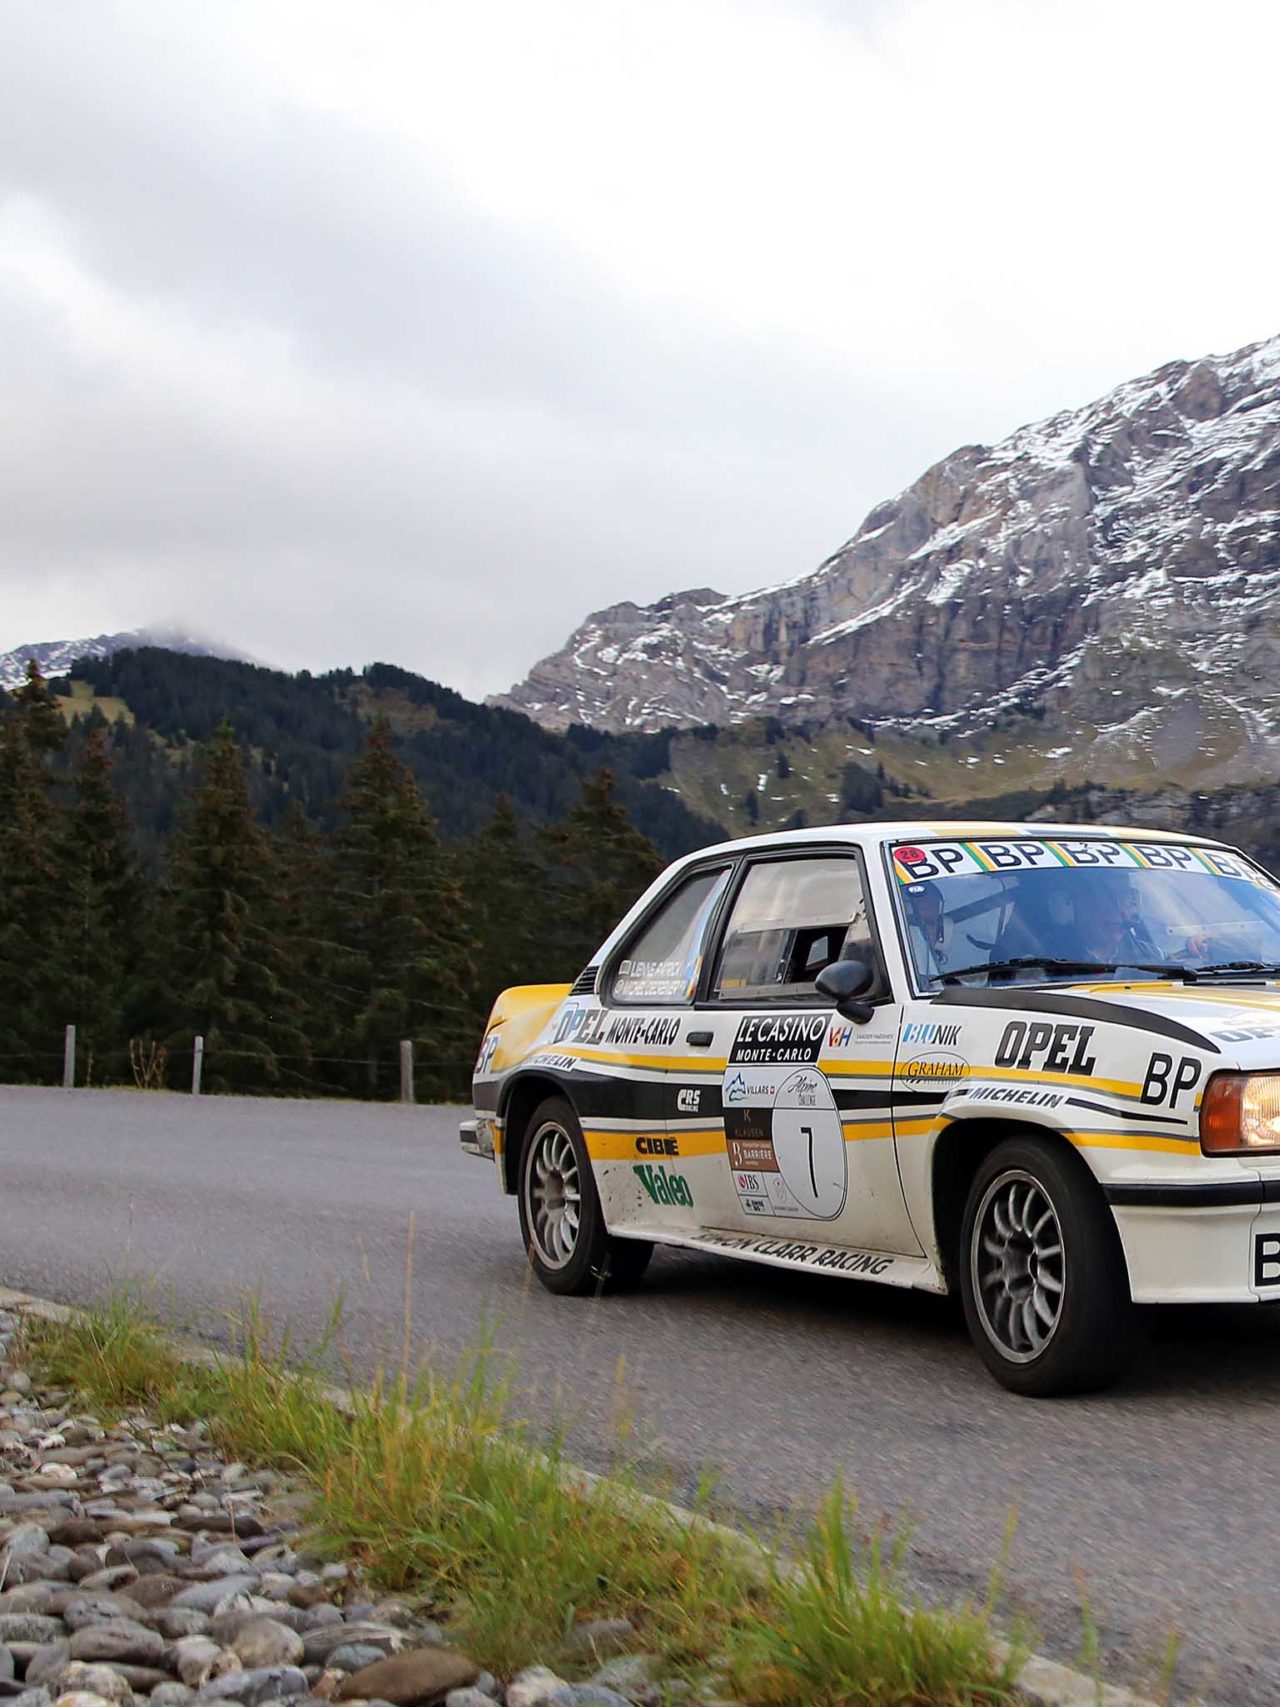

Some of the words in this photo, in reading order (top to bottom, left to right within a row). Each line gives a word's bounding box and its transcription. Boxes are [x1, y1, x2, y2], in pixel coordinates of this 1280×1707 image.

[979, 844, 1044, 868] BP
[1058, 843, 1120, 864] BP
[1131, 846, 1191, 869] BP
[605, 1017, 681, 1046] MONTE-CARLO
[737, 1018, 758, 1042] LE
[757, 1016, 826, 1042] CASINO
[902, 1023, 961, 1045] BLUNIK
[994, 1021, 1096, 1076] OPEL
[908, 1061, 964, 1078] GRAHAM
[1140, 1052, 1202, 1109] BP
[746, 1086, 769, 1095] VILLARS
[968, 1086, 1062, 1108] MICHELIN
[800, 1127, 818, 1198] 7
[633, 1164, 693, 1207] Valeo
[753, 1240, 813, 1263] CLARR
[811, 1246, 893, 1276] RACING
